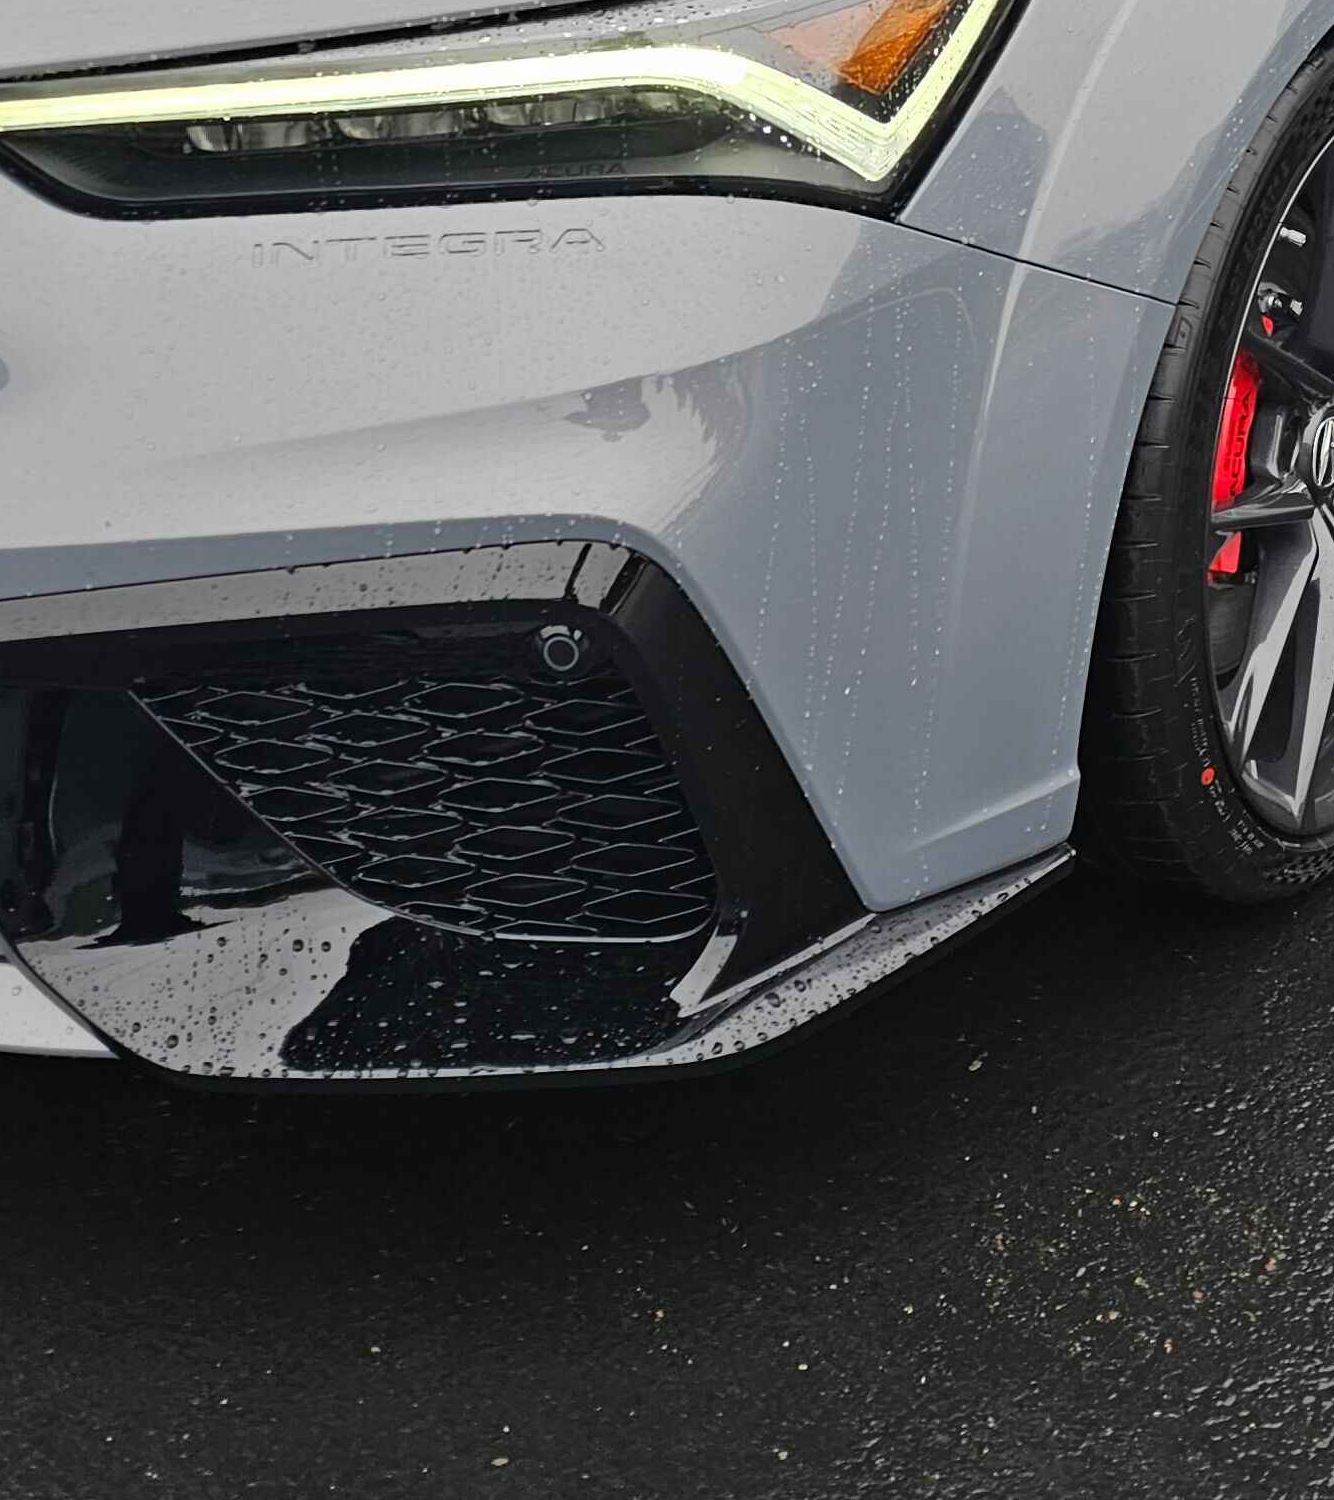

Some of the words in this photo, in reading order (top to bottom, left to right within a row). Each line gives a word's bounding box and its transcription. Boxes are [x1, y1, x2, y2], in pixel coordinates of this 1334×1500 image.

[525, 163, 626, 178] ACURA
[252, 228, 606, 267] INTEGRA
[1229, 389, 1252, 497] ACURA
